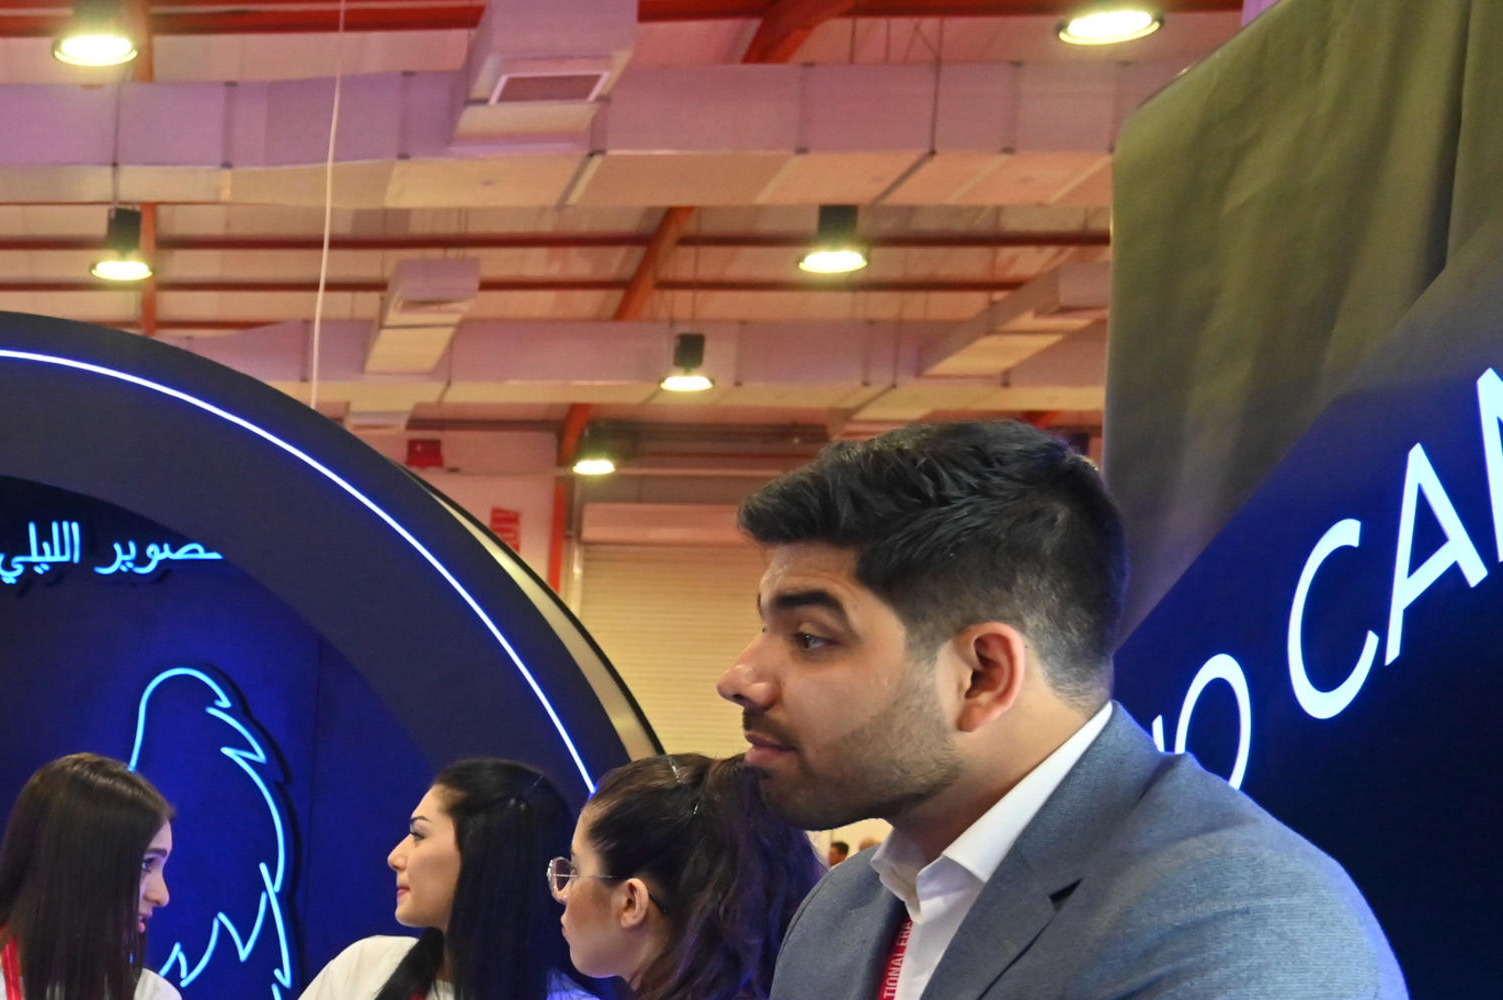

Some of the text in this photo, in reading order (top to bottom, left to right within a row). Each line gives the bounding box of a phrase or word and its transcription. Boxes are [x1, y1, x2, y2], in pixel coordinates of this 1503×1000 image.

[93, 540, 224, 575] صوير
[1152, 367, 1503, 790] O CA
